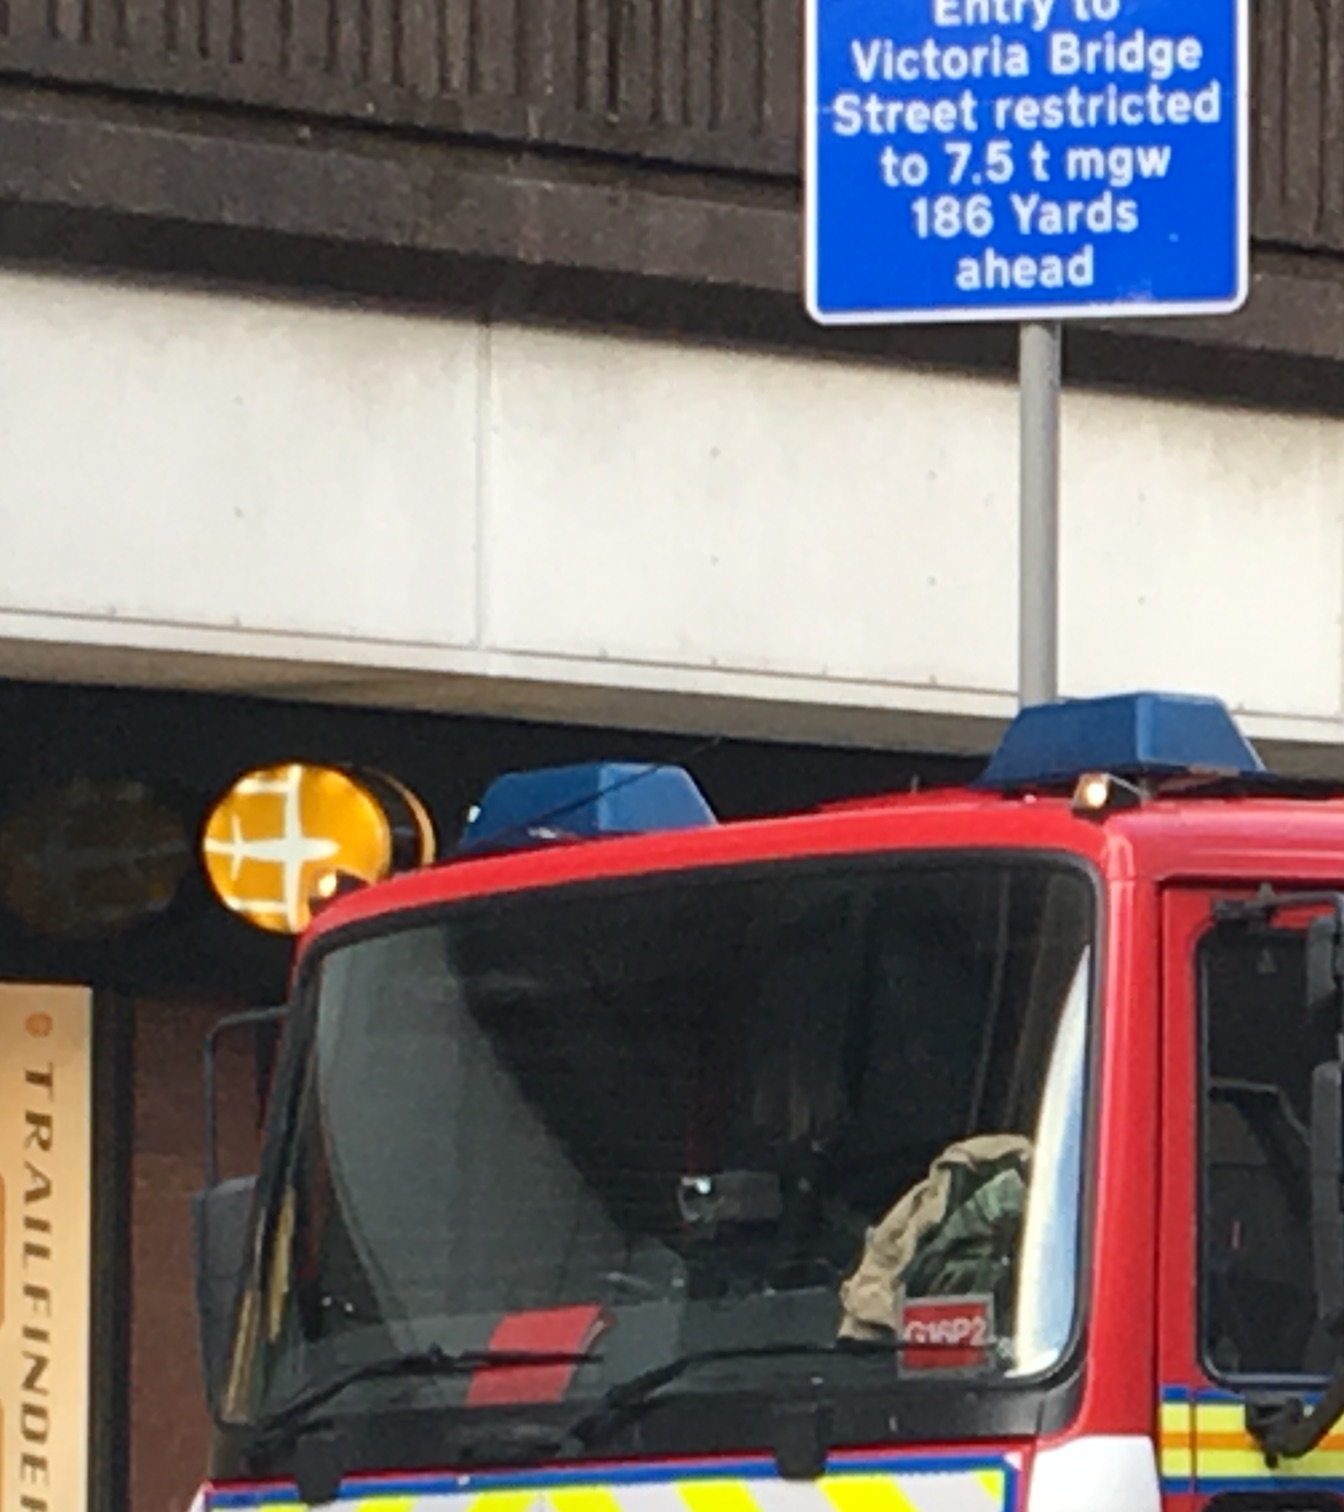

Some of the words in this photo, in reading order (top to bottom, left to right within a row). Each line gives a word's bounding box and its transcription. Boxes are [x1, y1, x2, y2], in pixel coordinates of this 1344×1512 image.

[933, 0, 1052, 31] Entry
[1074, 0, 1119, 21] to
[851, 36, 1029, 82] Victoria
[1050, 30, 1203, 79] Bridge
[833, 89, 978, 136] Street
[995, 80, 1221, 130] restricted
[881, 145, 928, 187] to
[944, 141, 1014, 185] 7.5
[1030, 140, 1050, 182] t
[1067, 145, 1171, 187] mgw
[911, 194, 994, 238] 186
[1010, 191, 1139, 236] Yards
[955, 244, 1095, 291] ahead
